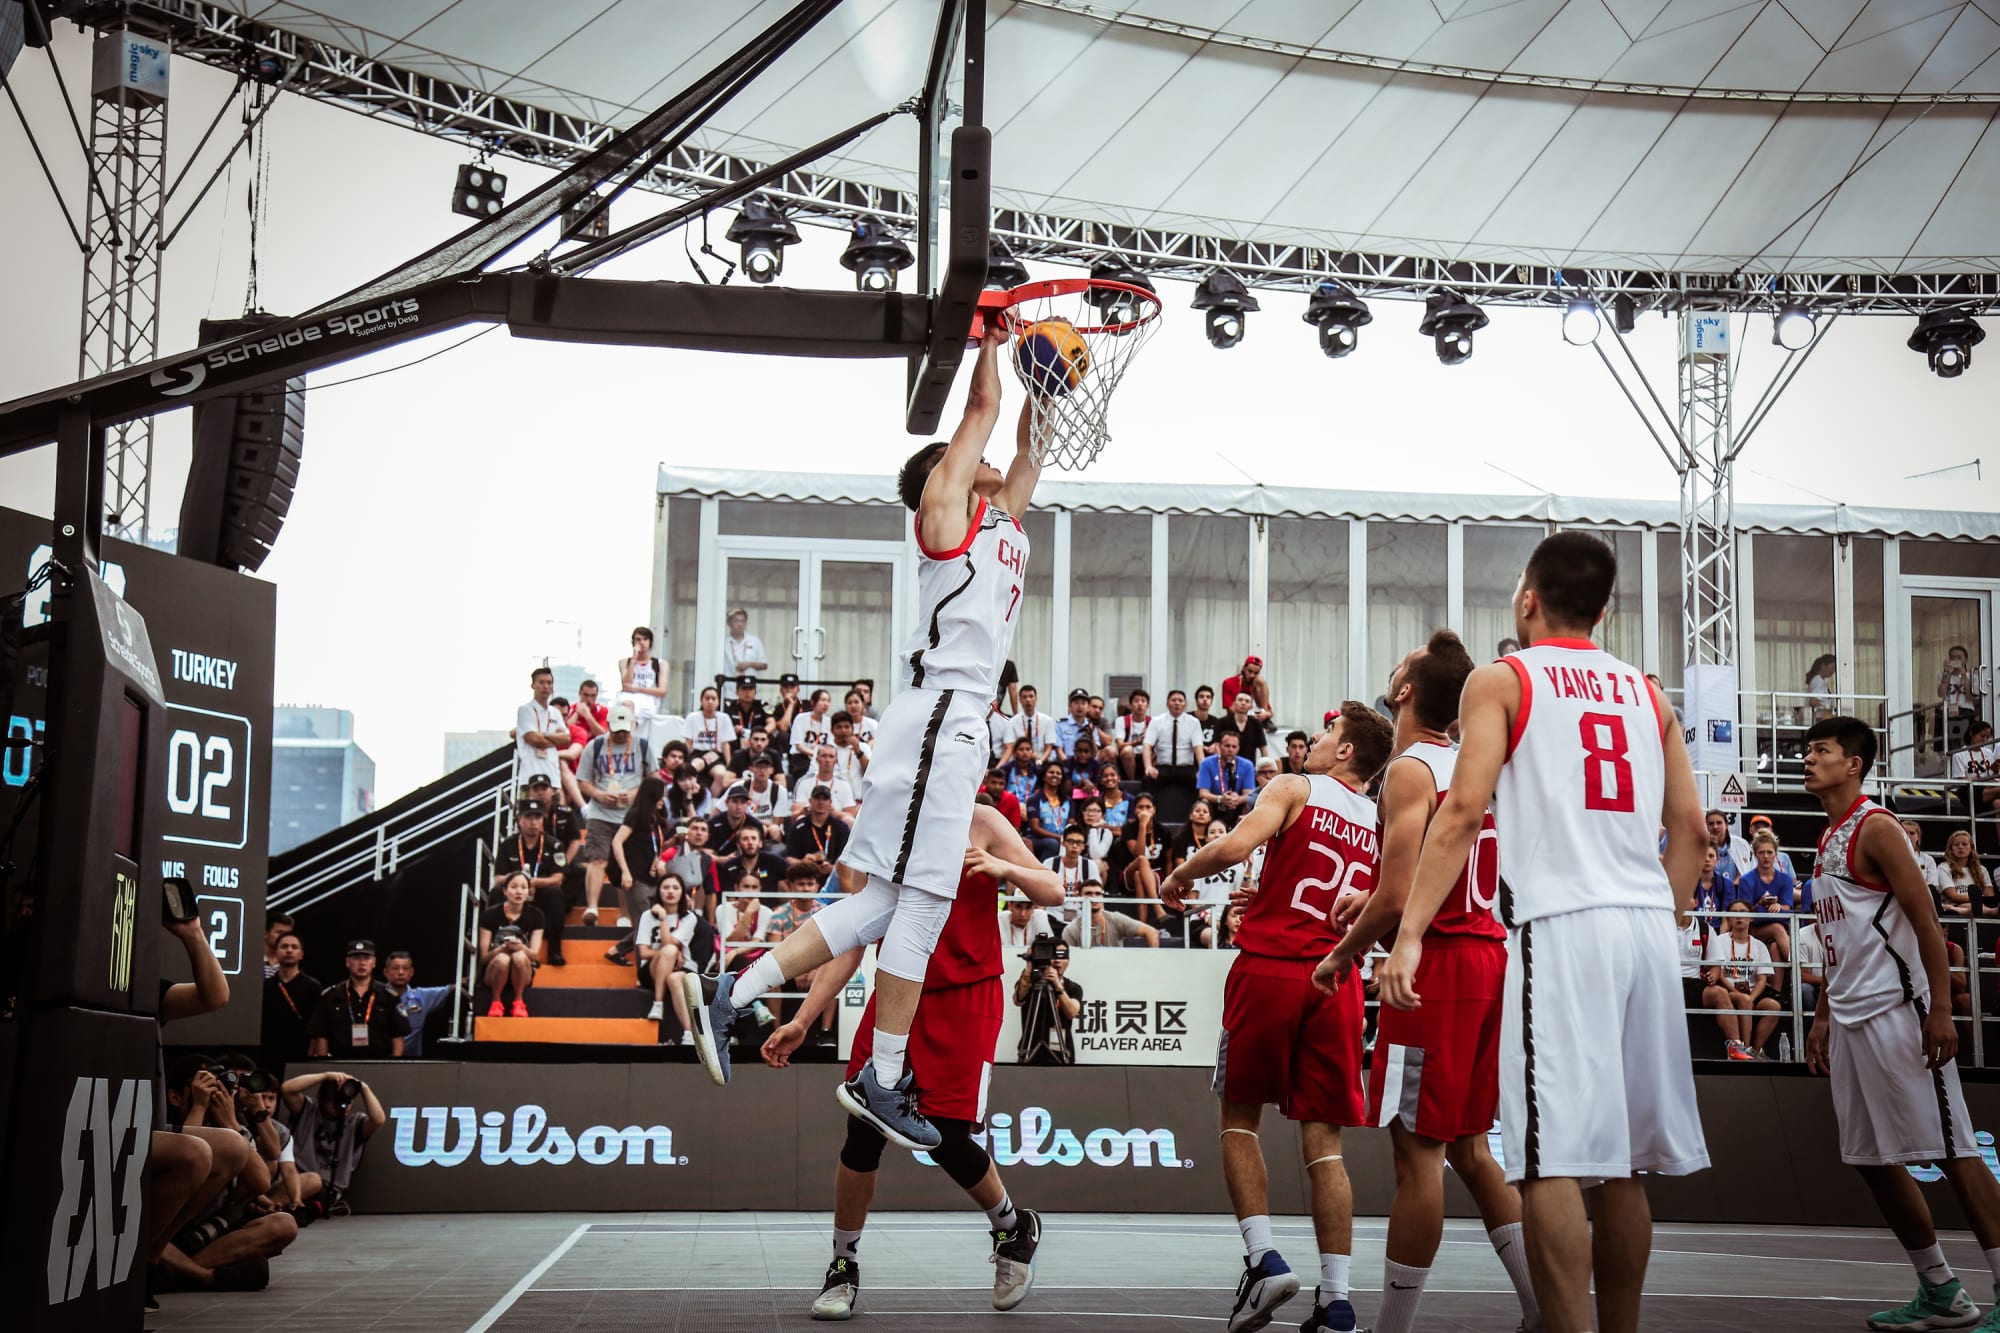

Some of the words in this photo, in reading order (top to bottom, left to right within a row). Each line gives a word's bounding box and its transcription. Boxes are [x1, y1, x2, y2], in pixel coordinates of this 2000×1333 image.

[129, 43, 140, 82] magic
[208, 323, 322, 369] Schelde
[327, 298, 419, 334] Sports
[355, 323, 386, 337] Superior
[387, 320, 397, 328] by
[1695, 319, 1704, 348] magic
[1004, 584, 1020, 622] 7
[172, 648, 238, 690] TURKEY
[1544, 667, 1604, 702] YANG
[1606, 672, 1625, 704] Z
[167, 729, 233, 820] 02
[601, 752, 635, 773] NYU
[1579, 711, 1635, 813] 8
[203, 864, 239, 888] FOULS
[210, 910, 228, 958] 2
[1825, 934, 1838, 967] 6
[1075, 1000, 1188, 1035] 球员区
[1081, 1037, 1138, 1051] PLAYER
[1141, 1038, 1182, 1051] AREA
[390, 1104, 677, 1167] Wilson
[911, 1106, 1183, 1168] ilson
